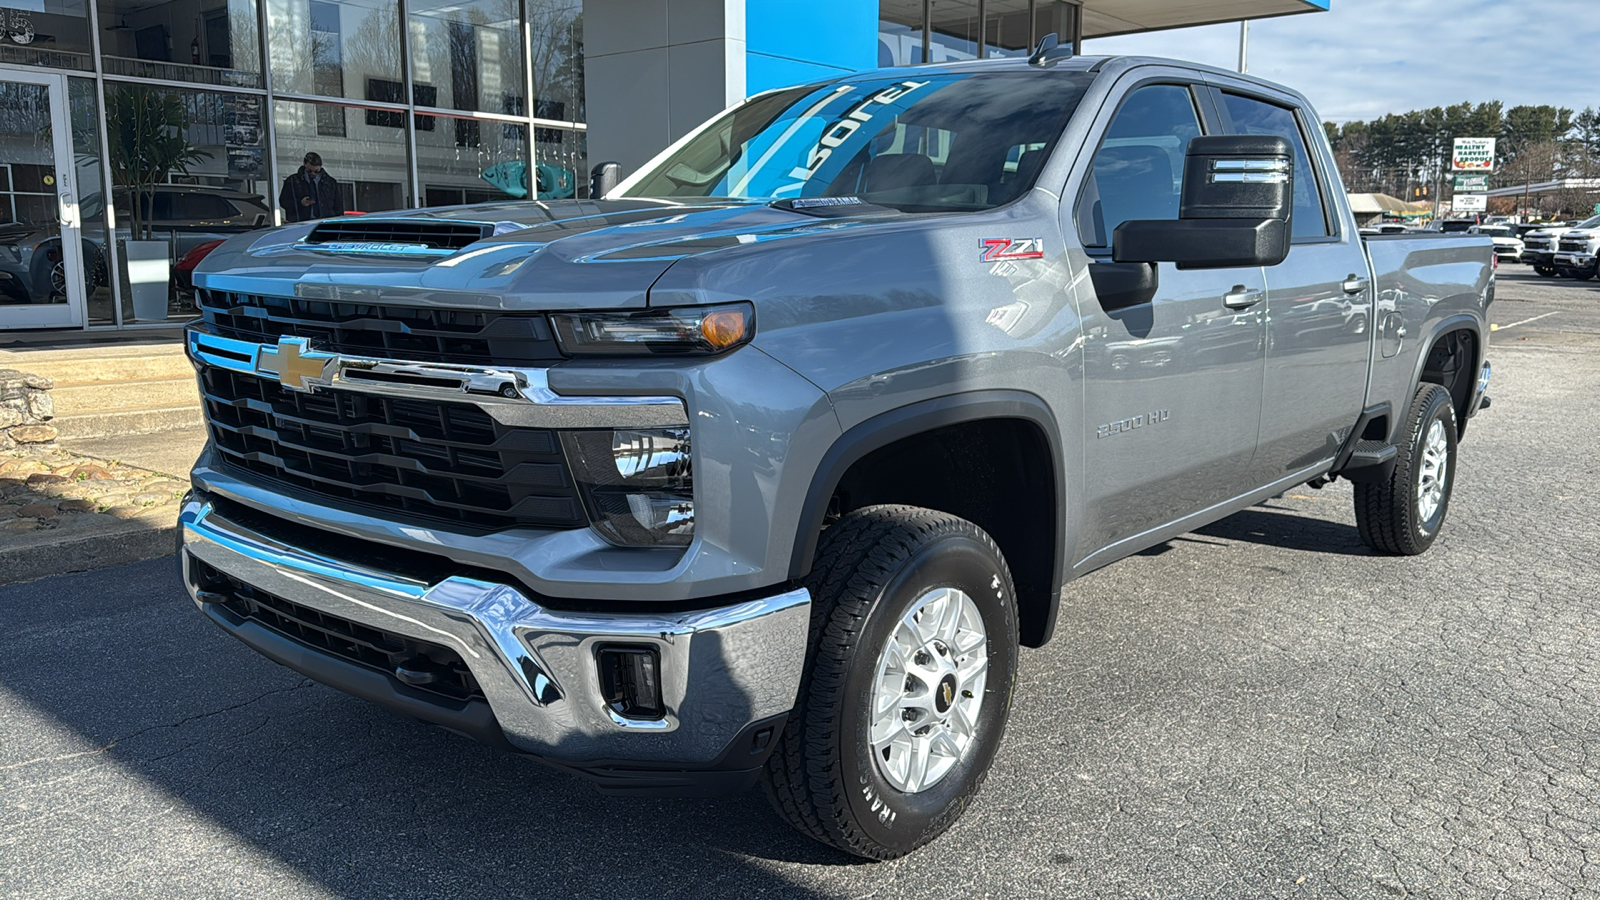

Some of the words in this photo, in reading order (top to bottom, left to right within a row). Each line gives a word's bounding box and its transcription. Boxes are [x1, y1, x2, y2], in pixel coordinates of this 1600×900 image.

[0, 8, 35, 45] 5
[328, 242, 410, 252] CHEVROLET
[978, 238, 1044, 263] Z71
[1097, 415, 1143, 440] 2500
[1147, 408, 1170, 425] HD
